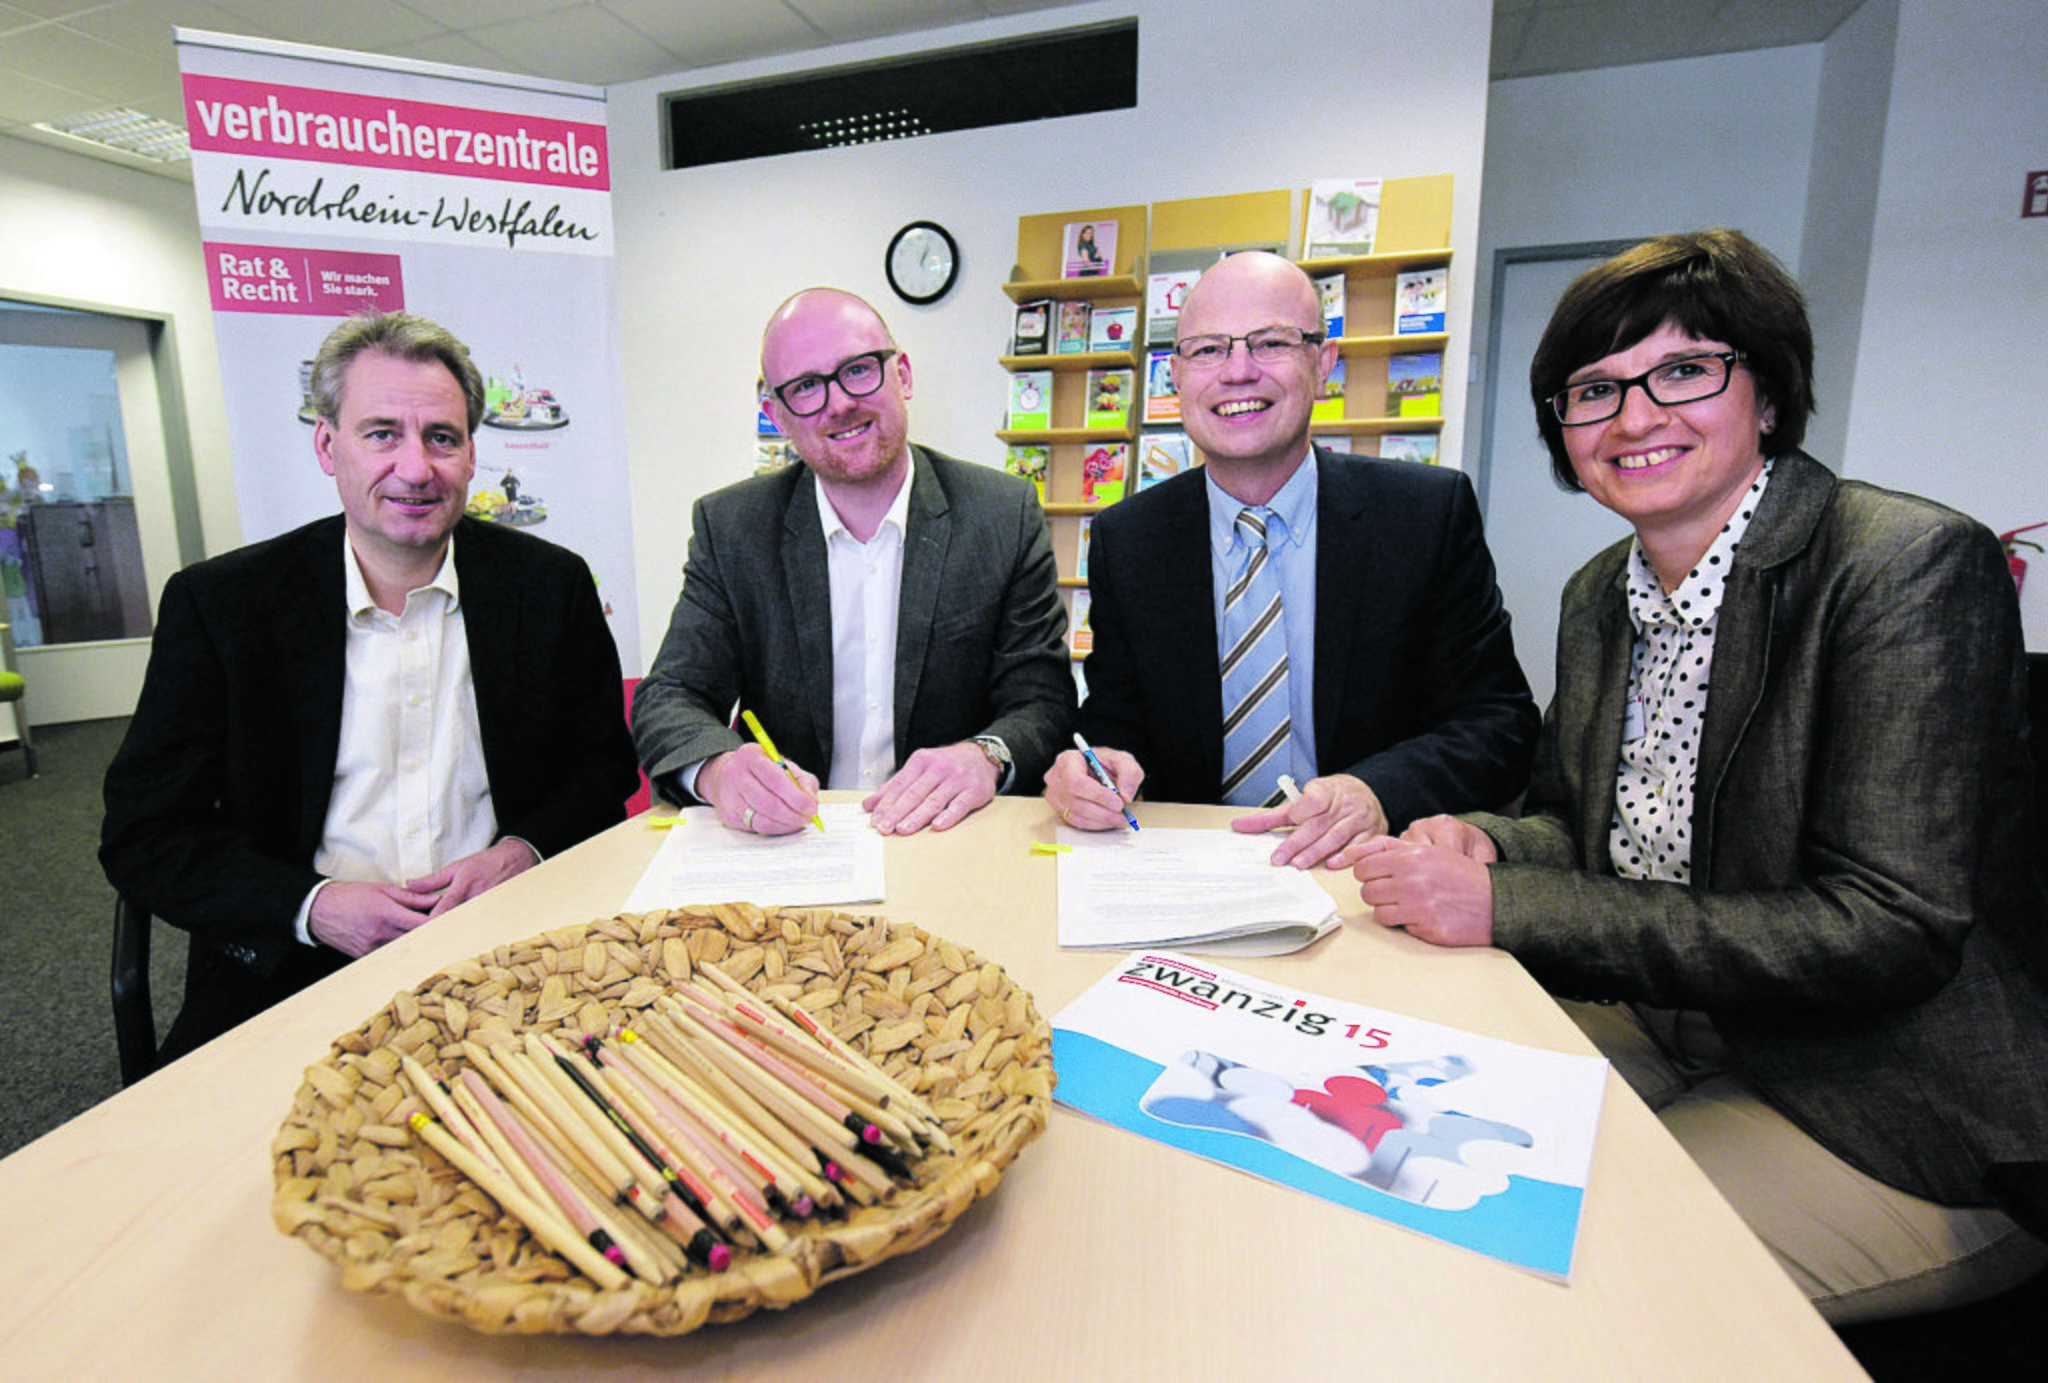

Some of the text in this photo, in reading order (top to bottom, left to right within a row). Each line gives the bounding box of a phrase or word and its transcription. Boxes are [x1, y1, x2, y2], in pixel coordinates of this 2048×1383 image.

[195, 95, 599, 177] verbraucherzentrale
[221, 168, 599, 248] Nordrhein-Westfalen
[219, 253, 292, 279] Rat &
[320, 270, 390, 285] Wir machen
[222, 277, 299, 303] Recht
[323, 283, 379, 297] Sie stark.
[1124, 961, 1337, 1037] zwanzig
[1344, 1024, 1392, 1049] 15
